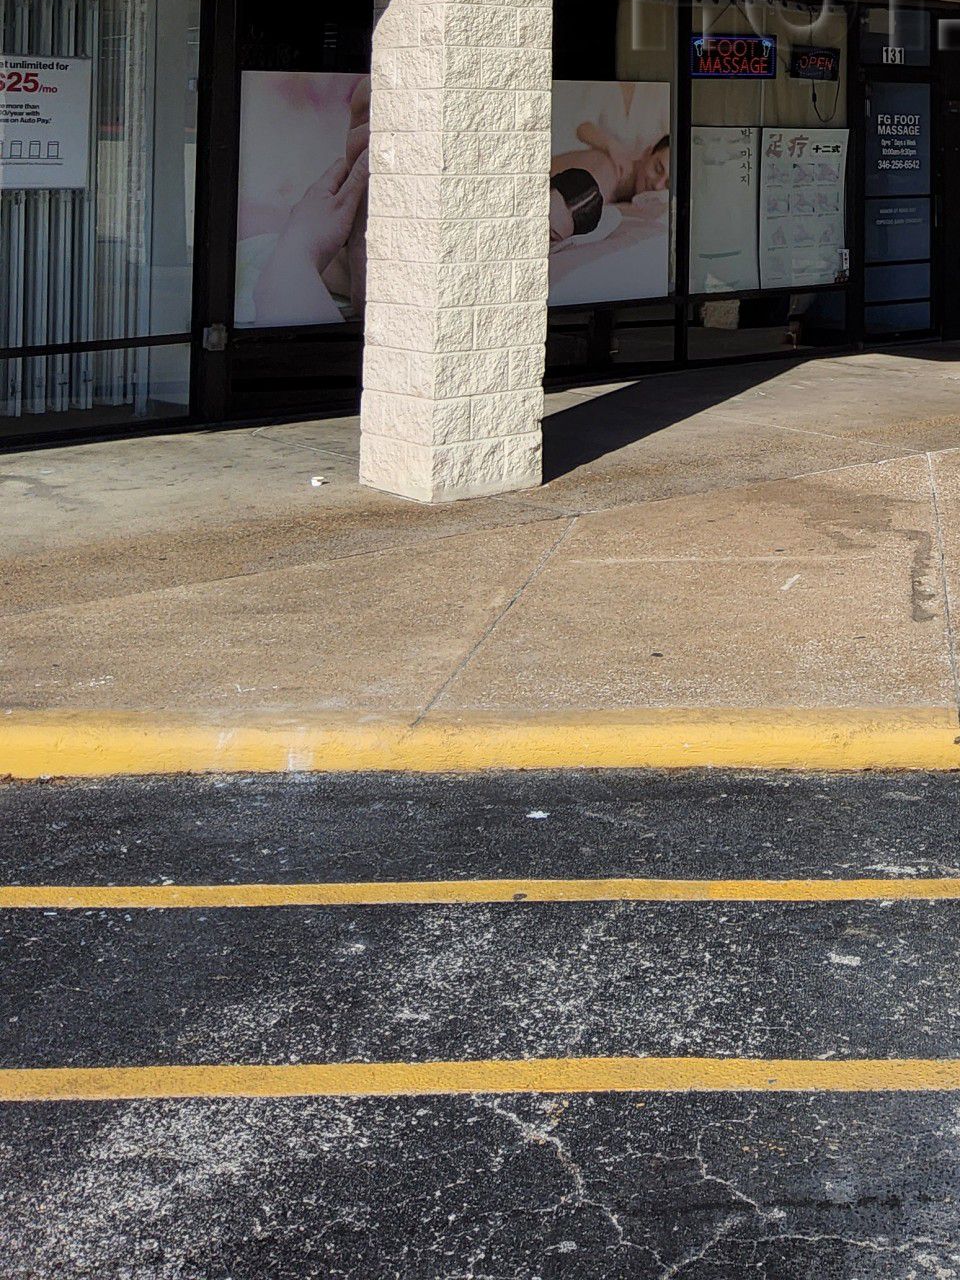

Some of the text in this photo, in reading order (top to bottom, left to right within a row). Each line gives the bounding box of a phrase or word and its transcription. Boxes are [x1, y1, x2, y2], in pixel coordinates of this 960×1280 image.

[706, 39, 759, 56] FOOT
[884, 47, 904, 64] 131
[10, 60, 54, 70] unlimited
[55, 62, 69, 71] for
[699, 57, 769, 74] MASSAGE
[800, 55, 833, 71] OPEN
[877, 115, 920, 125] FG FOOT
[877, 125, 920, 135] MASSAGE
[766, 133, 809, 158] 足疗
[812, 144, 841, 154] 十二式
